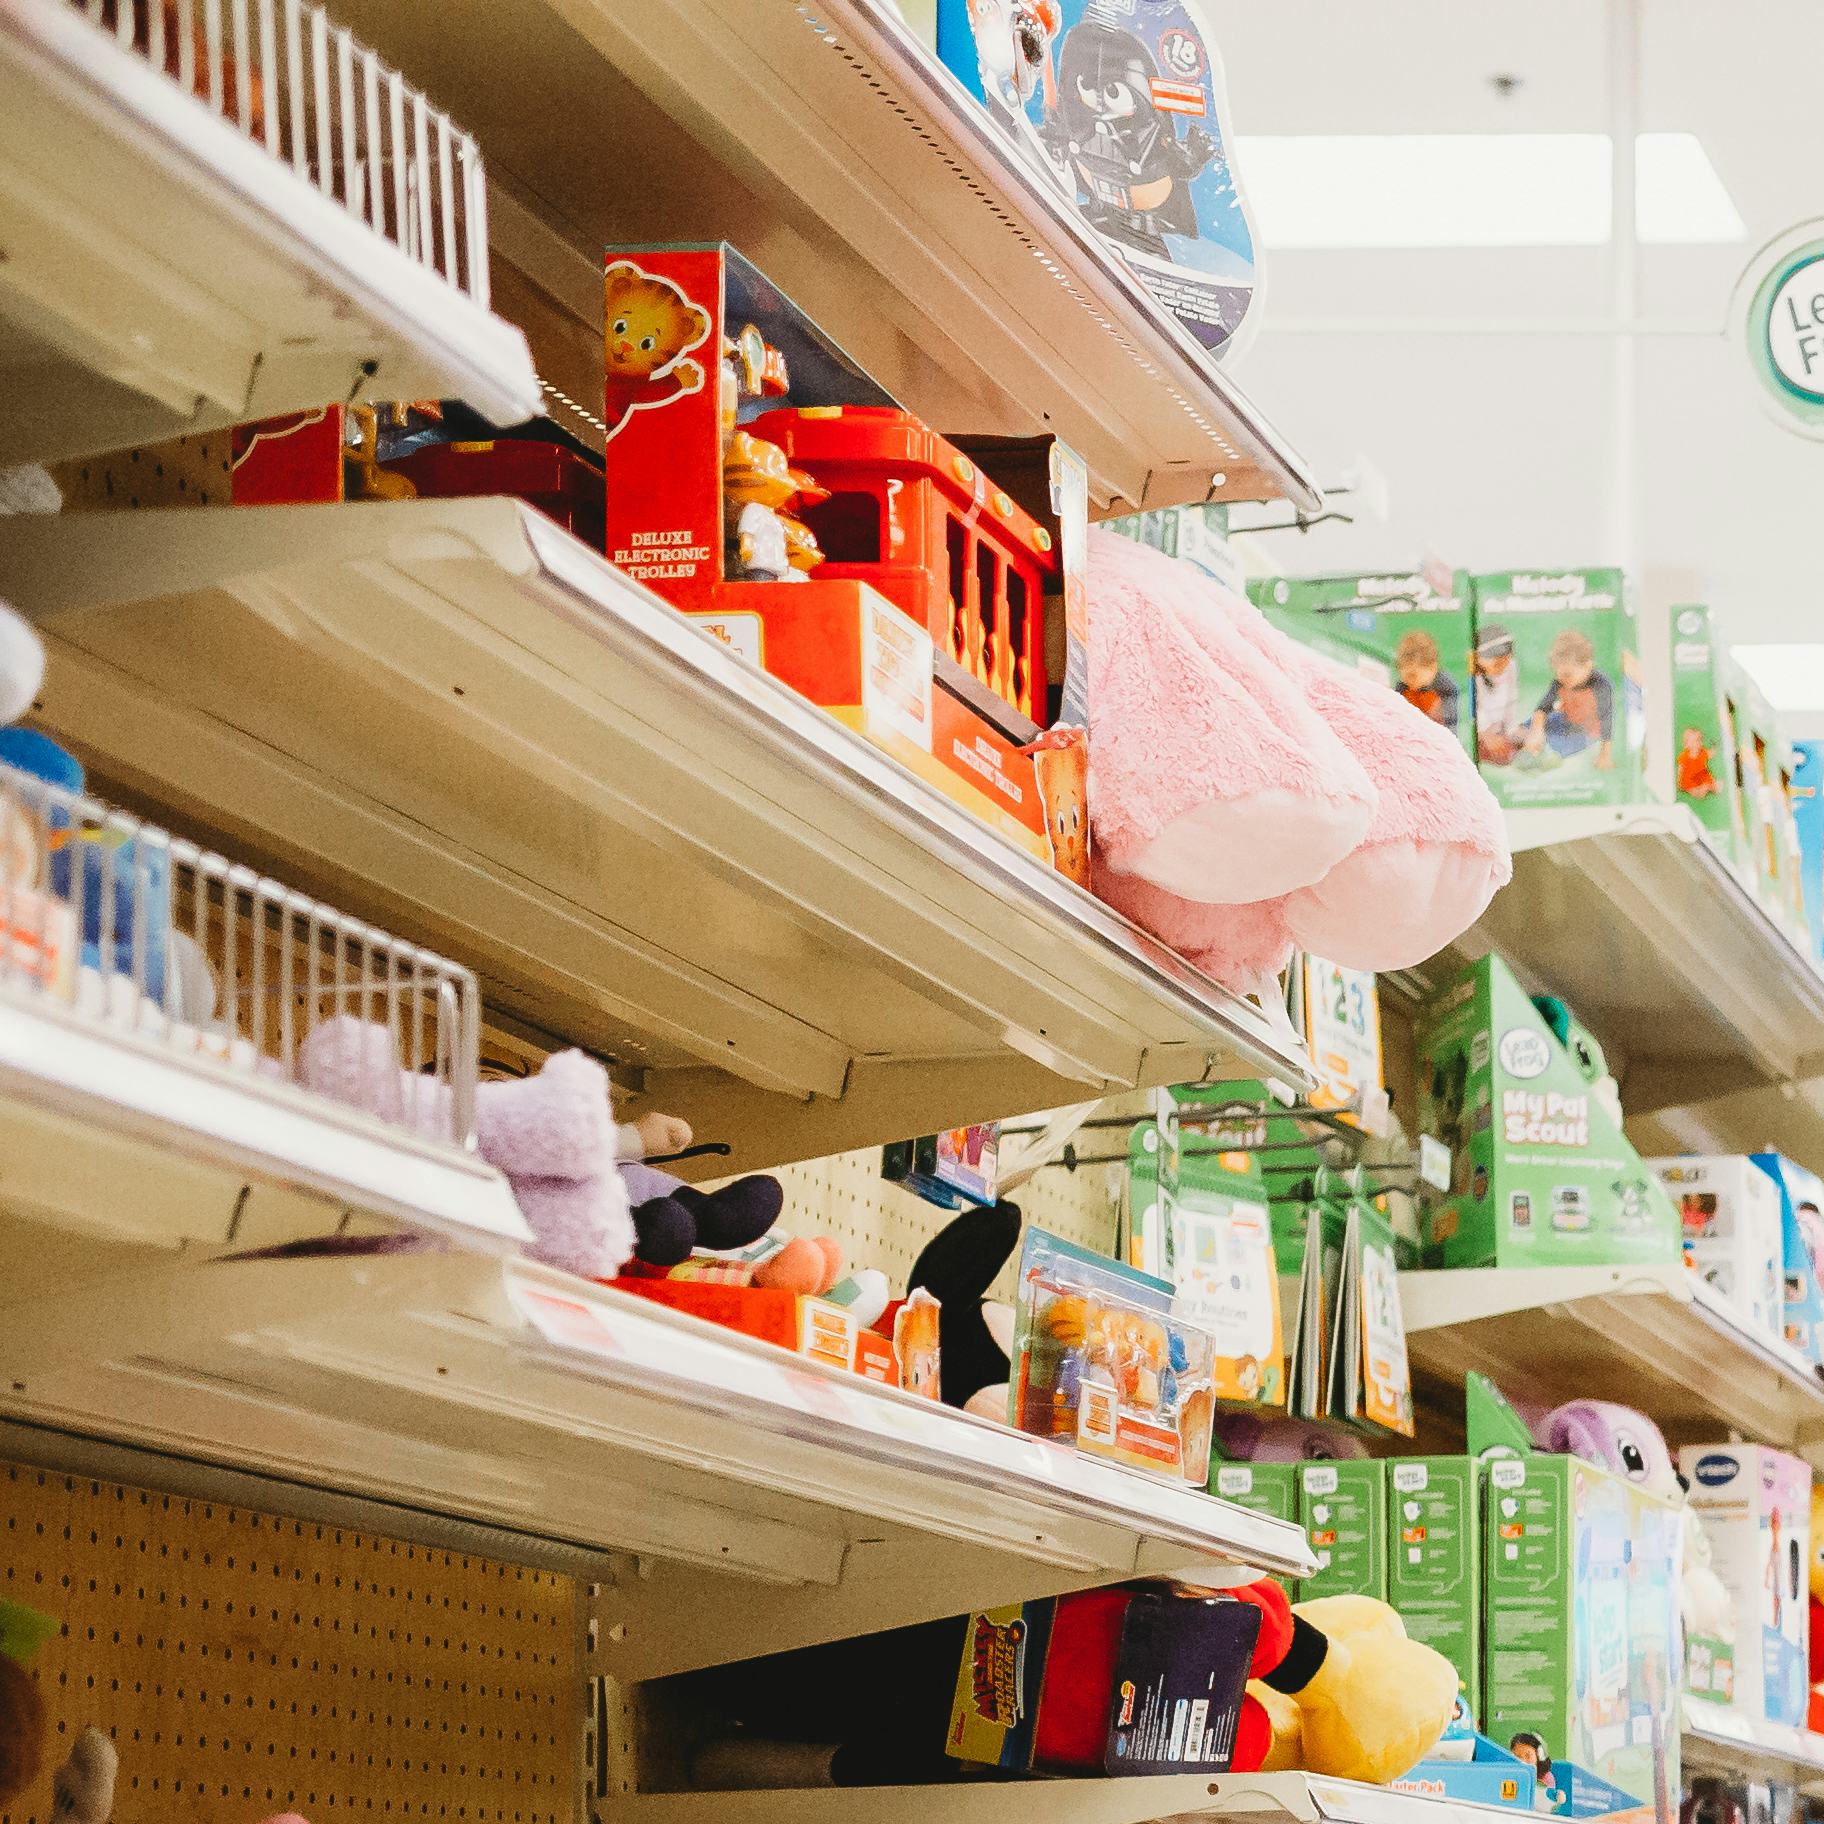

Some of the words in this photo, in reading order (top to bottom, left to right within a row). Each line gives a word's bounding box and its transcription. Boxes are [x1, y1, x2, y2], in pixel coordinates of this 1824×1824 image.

[631, 531, 692, 546] DELUXE
[614, 547, 710, 563] ELECTRONIC
[628, 564, 696, 579] TROLLEY
[1504, 1091, 1542, 1119] My
[1547, 1093, 1588, 1120] Pal
[1504, 1116, 1588, 1147] Scout
[973, 1614, 998, 1723] MICKEY
[994, 1626, 1012, 1726] ROADSTER
[1420, 1779, 1445, 1793] Pack
